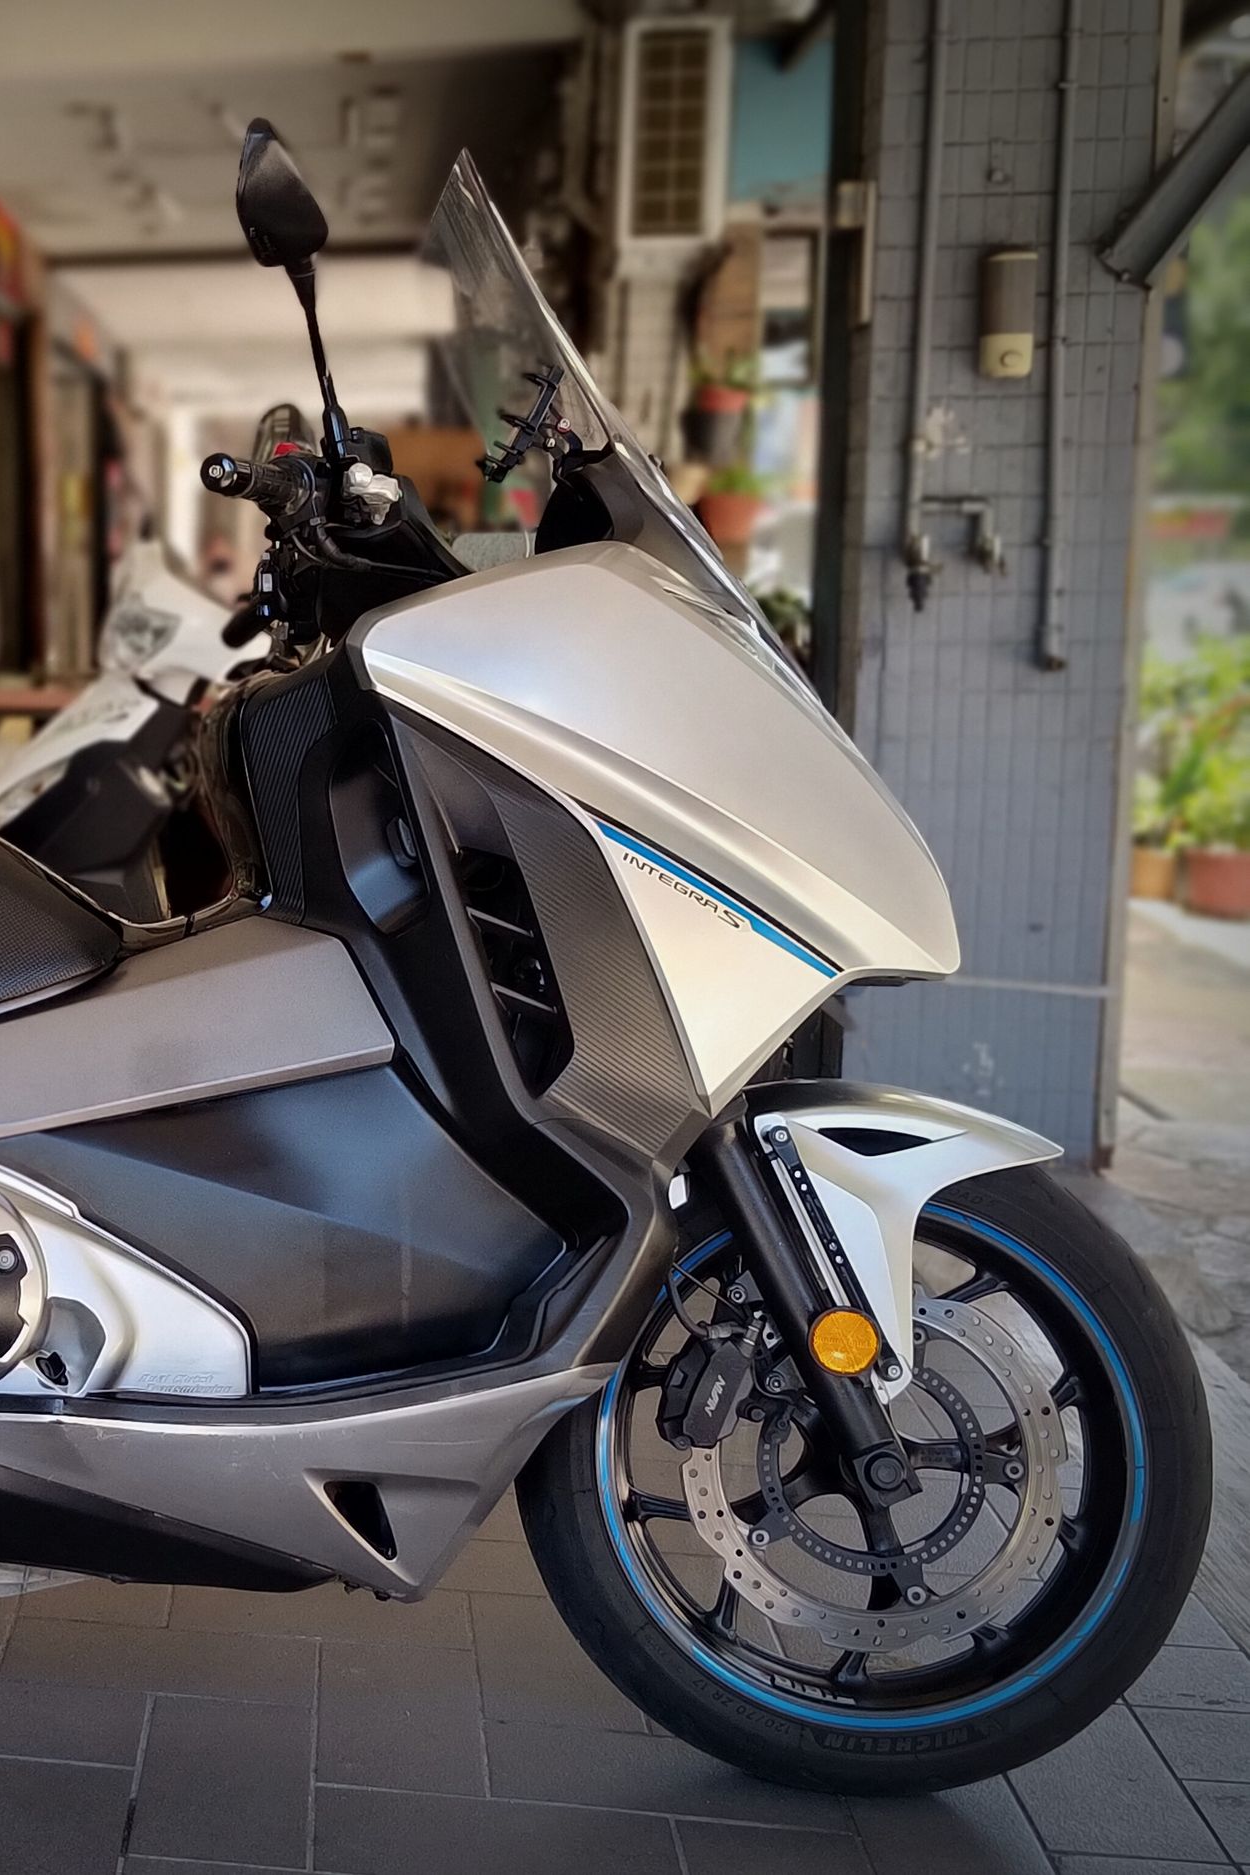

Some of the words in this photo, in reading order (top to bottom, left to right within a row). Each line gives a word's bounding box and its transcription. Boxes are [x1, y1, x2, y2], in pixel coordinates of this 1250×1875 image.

[622, 852, 719, 914] INTEGRA
[717, 908, 746, 930] S
[823, 1726, 969, 1753] MICHELIN
